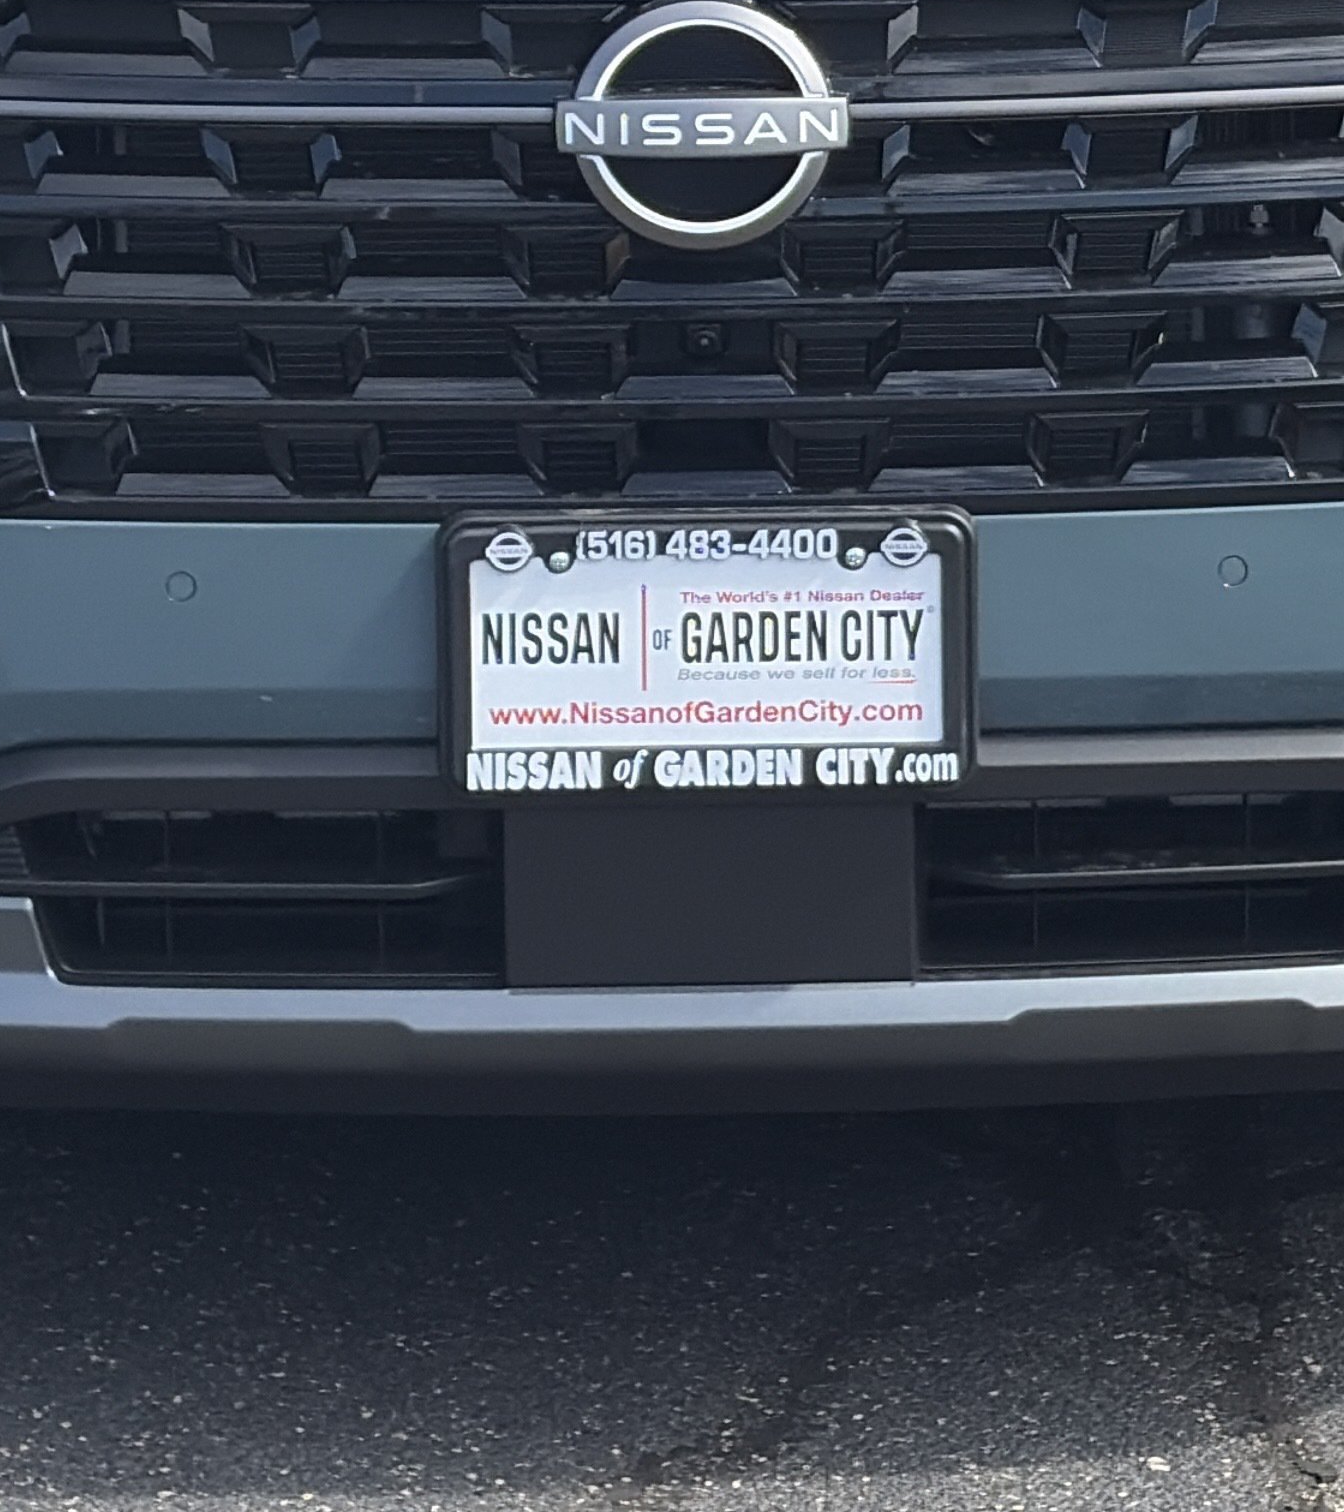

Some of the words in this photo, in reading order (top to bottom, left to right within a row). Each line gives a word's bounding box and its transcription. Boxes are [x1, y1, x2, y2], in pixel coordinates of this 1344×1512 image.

[563, 108, 840, 146] NISSAN
[575, 530, 656, 561] (516)
[665, 528, 839, 560] 483-4400
[680, 592, 711, 604] The
[716, 590, 779, 603] World's
[783, 591, 802, 602] #1
[808, 590, 865, 603] Nissan
[870, 590, 925, 602] Dealer
[482, 613, 620, 665] NISSAN
[653, 629, 672, 651] OF
[681, 610, 828, 664] GARDEN
[840, 609, 924, 662] CITY
[677, 668, 761, 681] Because
[767, 670, 796, 680] we
[802, 667, 835, 680] sell
[840, 666, 867, 679] for
[872, 666, 916, 679] less.
[489, 699, 923, 726] www.NissanofGardenCity.com
[467, 751, 603, 791] NISSAN
[613, 749, 649, 789] of
[654, 749, 803, 788] GARDEN
[815, 747, 959, 786] CITY.com
